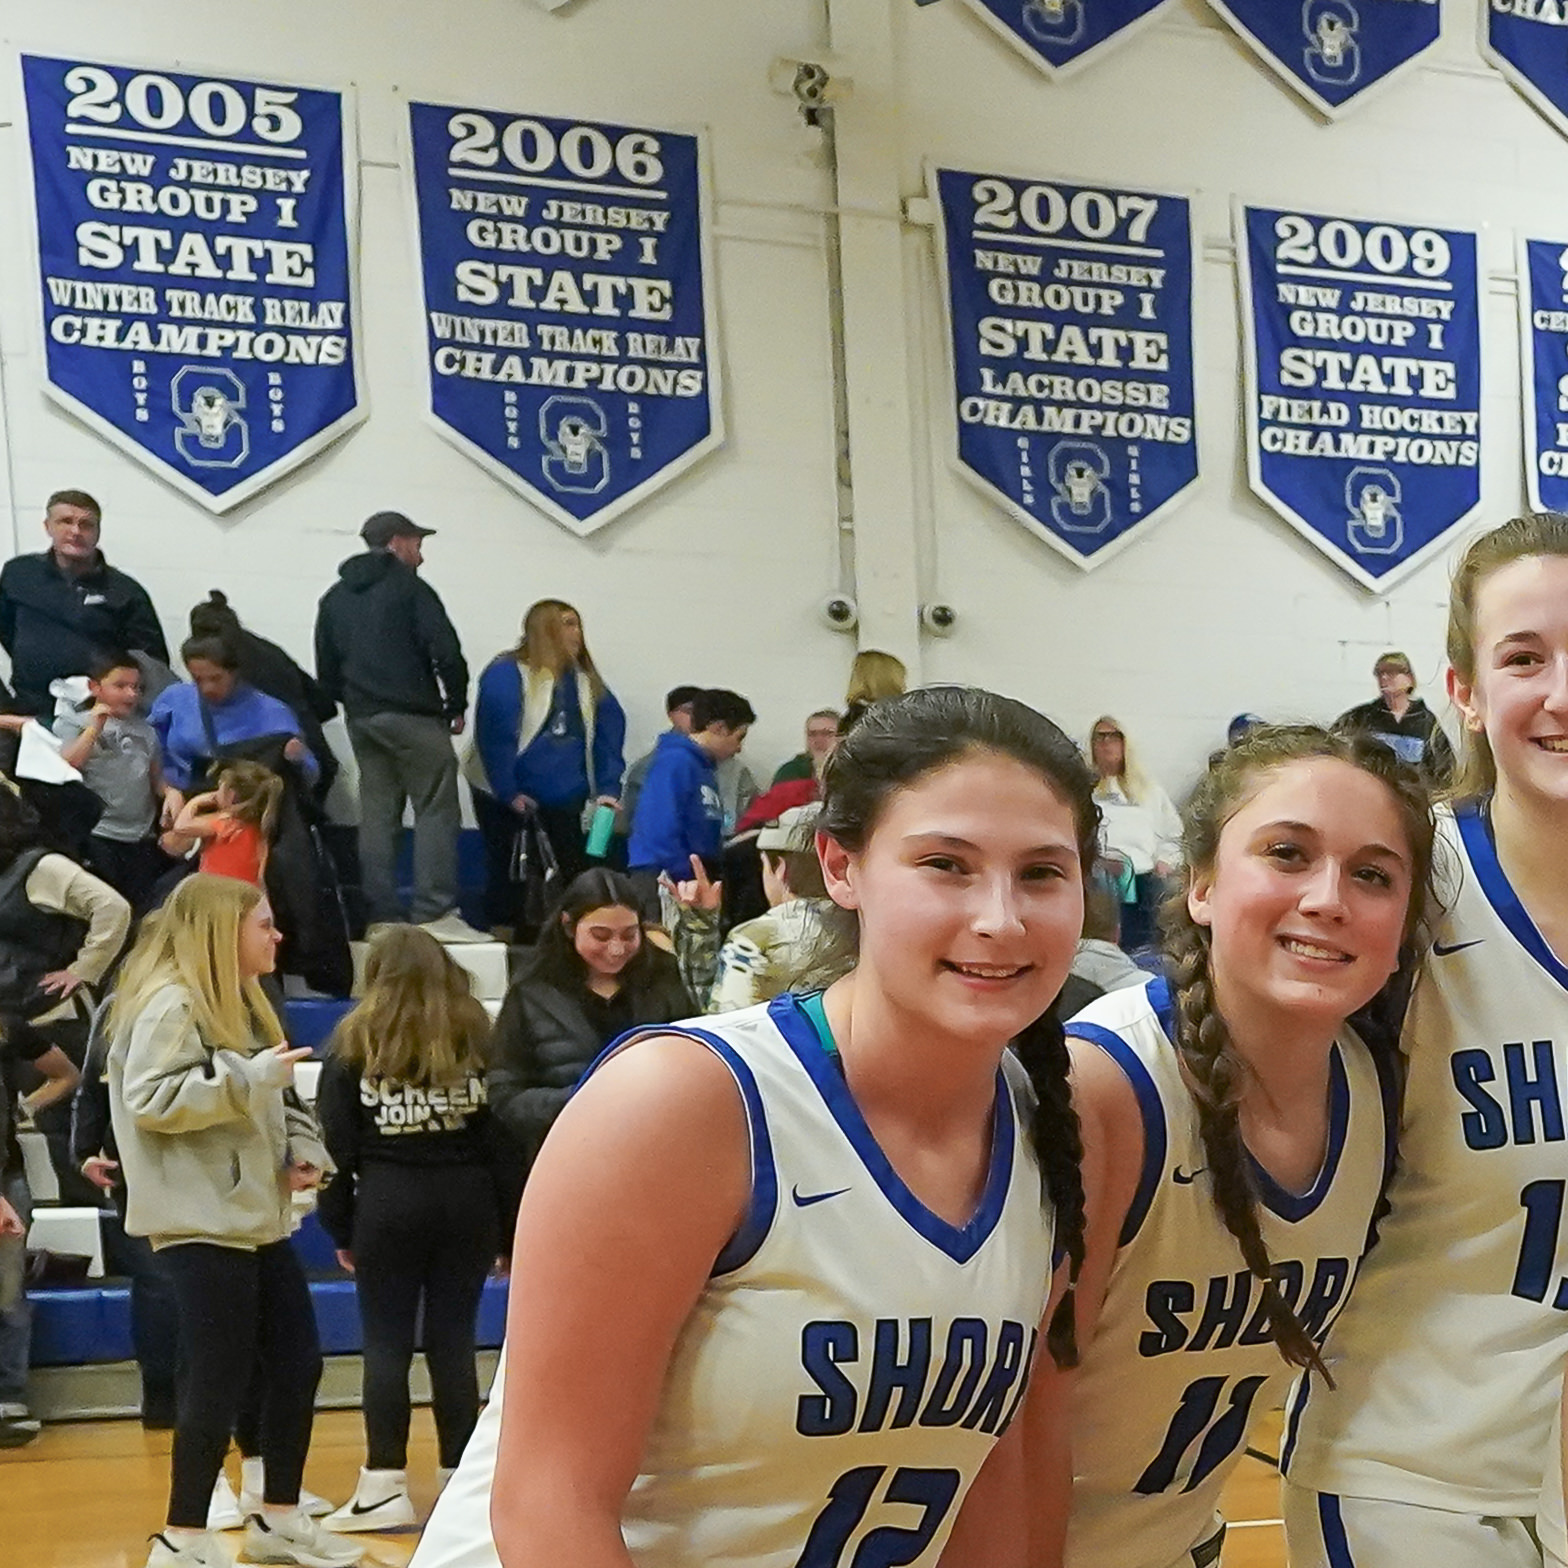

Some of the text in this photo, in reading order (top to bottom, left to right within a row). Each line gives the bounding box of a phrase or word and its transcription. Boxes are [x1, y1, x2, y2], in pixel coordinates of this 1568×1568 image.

[65, 66, 302, 143] 2005
[66, 146, 310, 193] NEW JERSEY
[448, 113, 664, 185] 2006
[86, 179, 298, 228] GROUP I
[449, 188, 671, 233] NEW JERSEY
[972, 179, 1158, 243] 2007
[76, 221, 315, 287] STATE
[466, 218, 658, 265] GROUP I
[1275, 215, 1451, 277] 2009
[455, 260, 673, 321] STATE
[974, 250, 1166, 289] NEW JERSEY
[47, 277, 346, 328] WINTER TRACK RELAY
[988, 278, 1157, 320] GROUP I
[1277, 283, 1455, 320] NEW JERSEY
[51, 315, 347, 365] CHAMPIONS
[430, 312, 701, 363] WINTER TRACK RELAY
[978, 316, 1170, 372] STATE
[1290, 310, 1445, 350] GROUP I
[434, 346, 703, 398] CHAMPIONS
[980, 368, 1170, 410] LACROSSE
[1280, 347, 1456, 399] STATE
[960, 397, 1191, 444] CHAMPIONS
[1260, 394, 1478, 435] FIELD HOCKEY
[1261, 426, 1479, 466] CHAMPIONS
[1138, 1255, 1363, 1357] SHOR
[1131, 1374, 1270, 1494] 11
